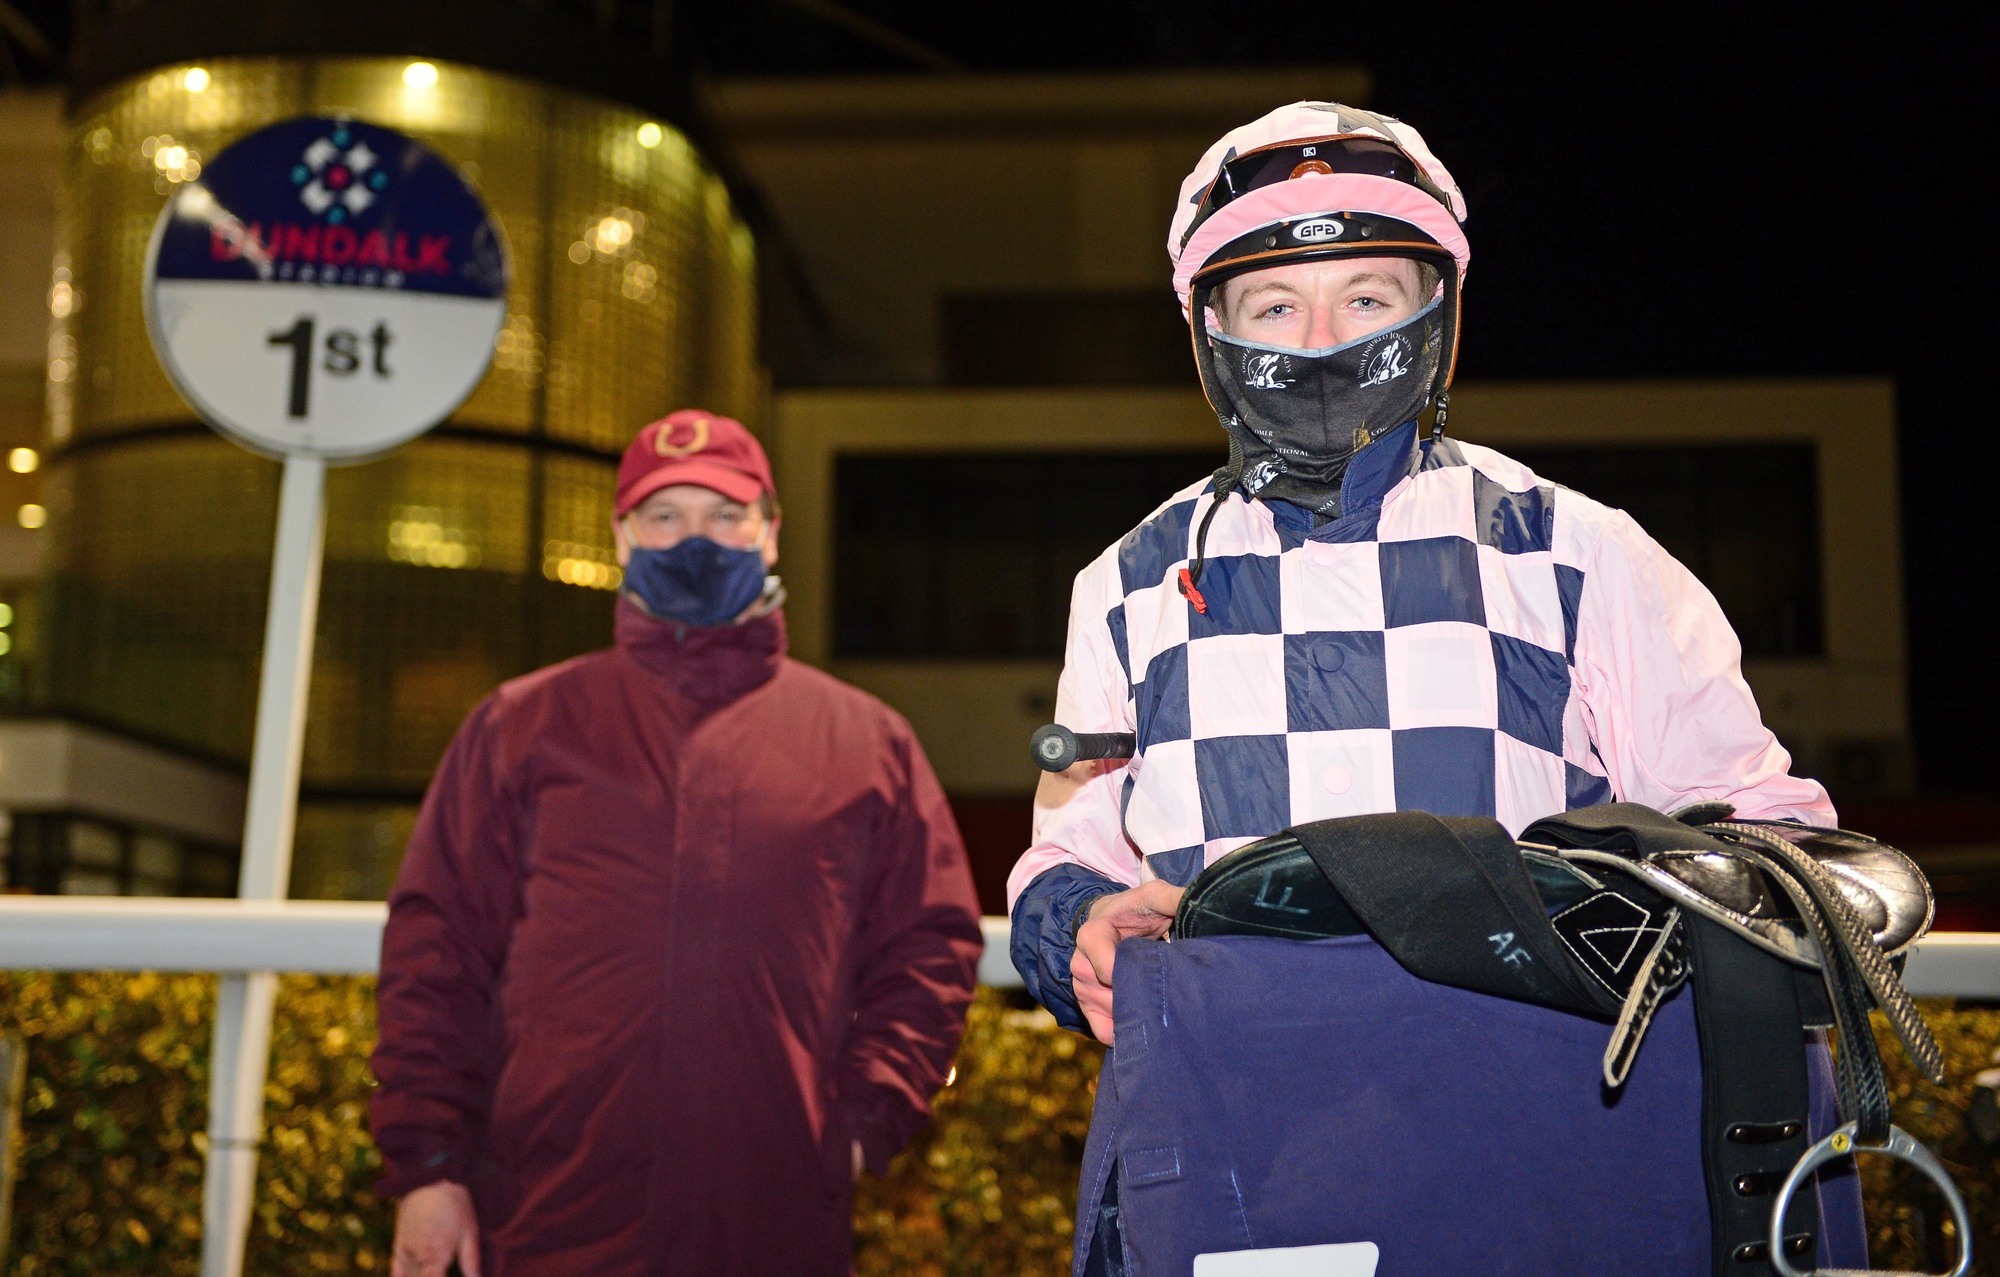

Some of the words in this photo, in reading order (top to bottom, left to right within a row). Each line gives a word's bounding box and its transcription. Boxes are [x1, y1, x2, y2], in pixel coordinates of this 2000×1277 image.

[1300, 223, 1337, 238] GPA
[210, 220, 452, 277] DUNDALK
[1362, 334, 1389, 357] INJURED
[1389, 331, 1413, 352] JOCKEYS
[266, 314, 394, 420] 1st
[1254, 429, 1274, 437] OMER
[1275, 447, 1310, 457] TIONAL
